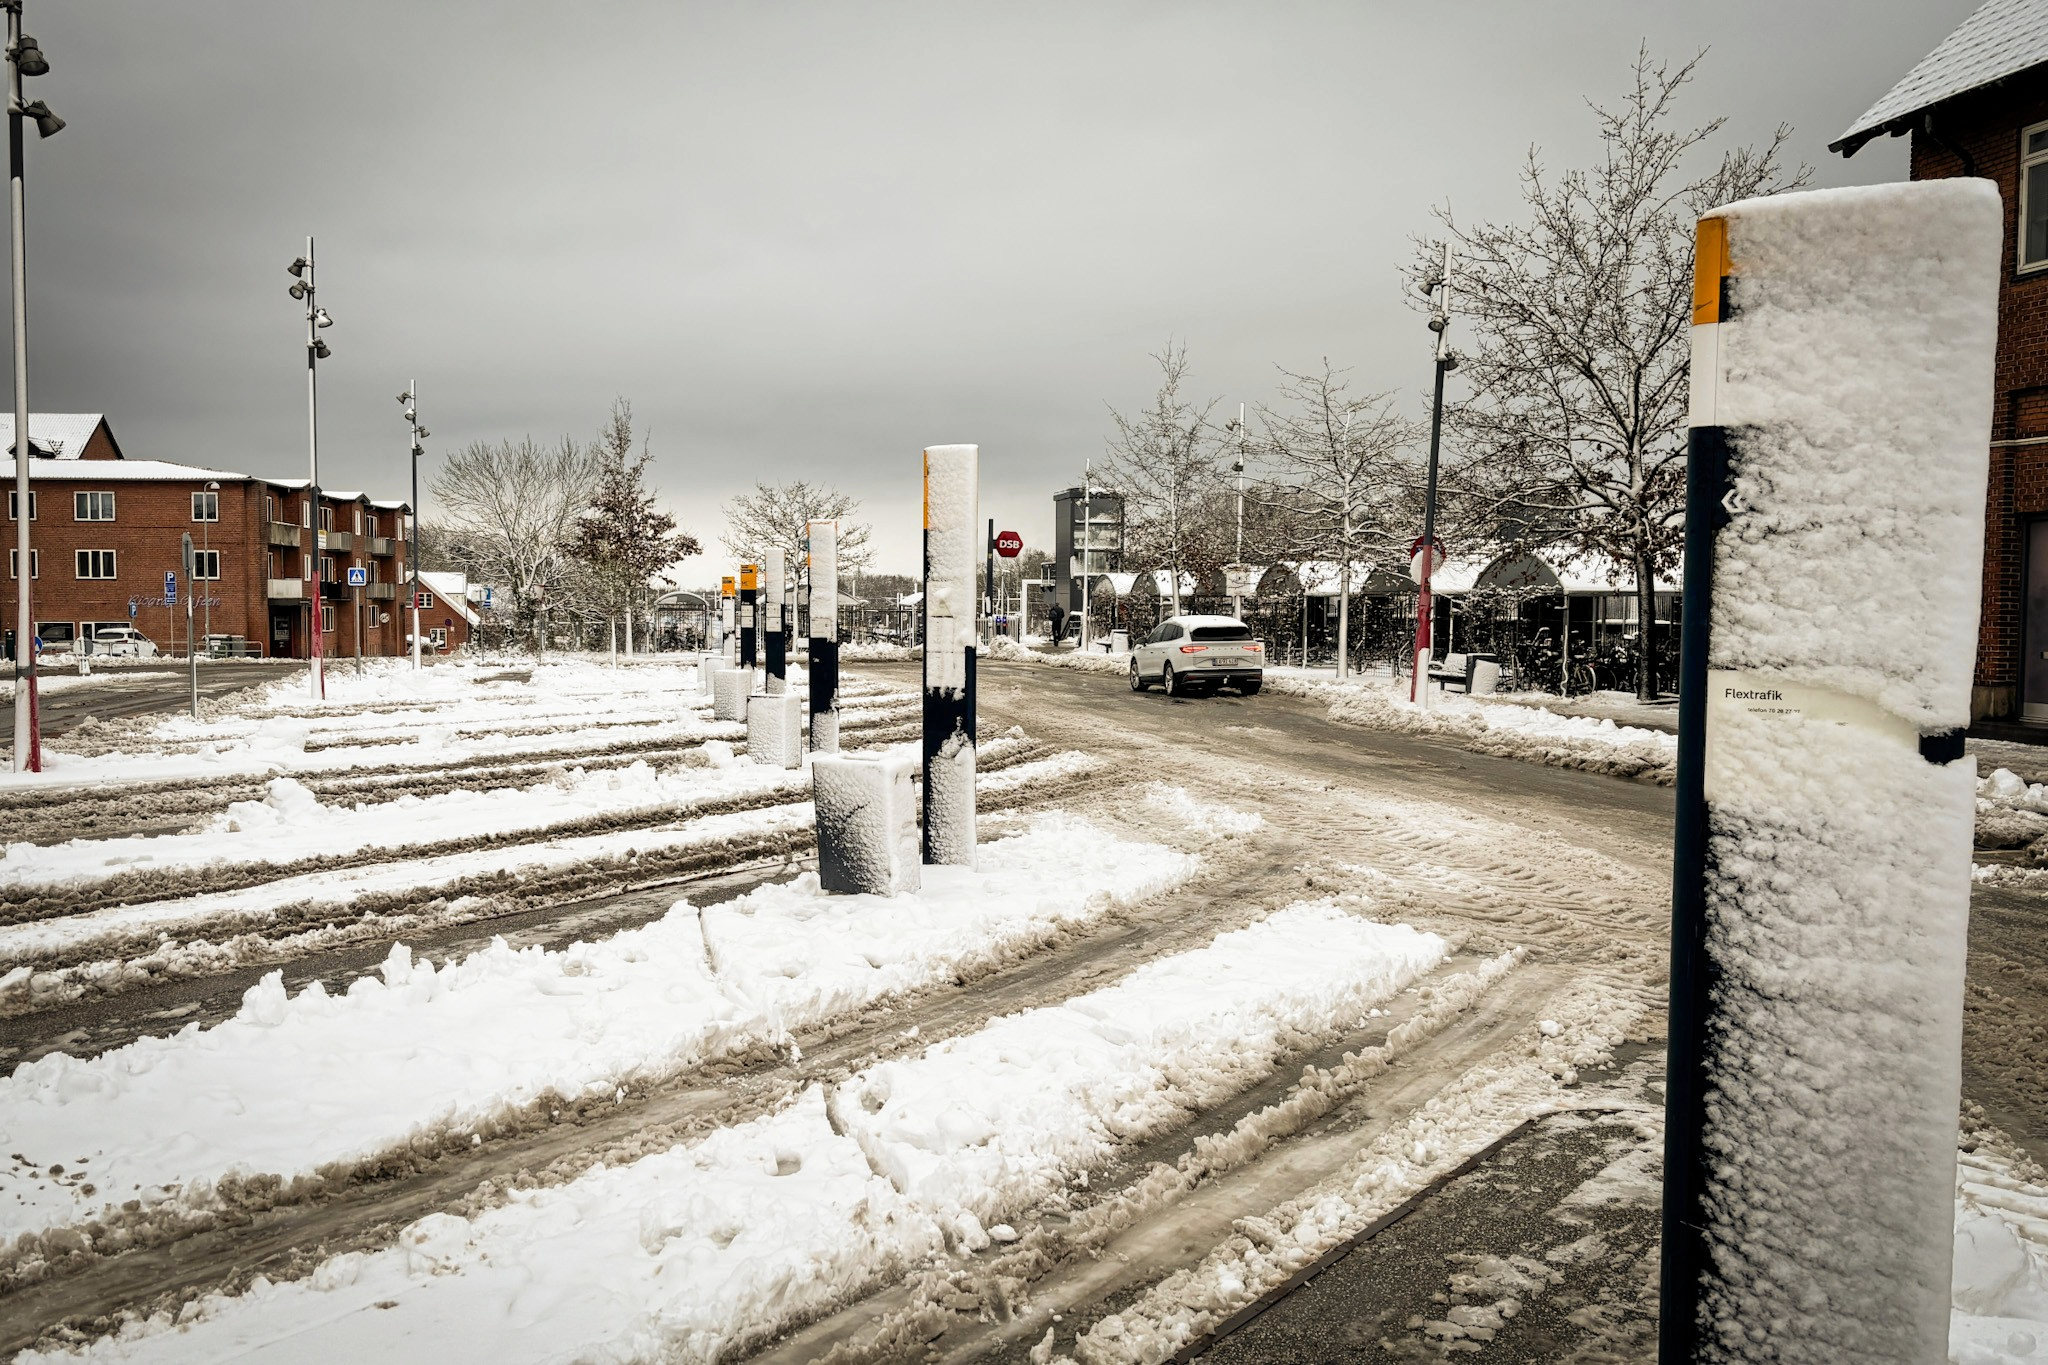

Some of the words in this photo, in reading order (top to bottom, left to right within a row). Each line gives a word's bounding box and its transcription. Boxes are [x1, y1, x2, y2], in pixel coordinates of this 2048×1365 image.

[999, 540, 1020, 549] DSB
[167, 572, 174, 582] P
[1725, 688, 1783, 701] Flextrafik
